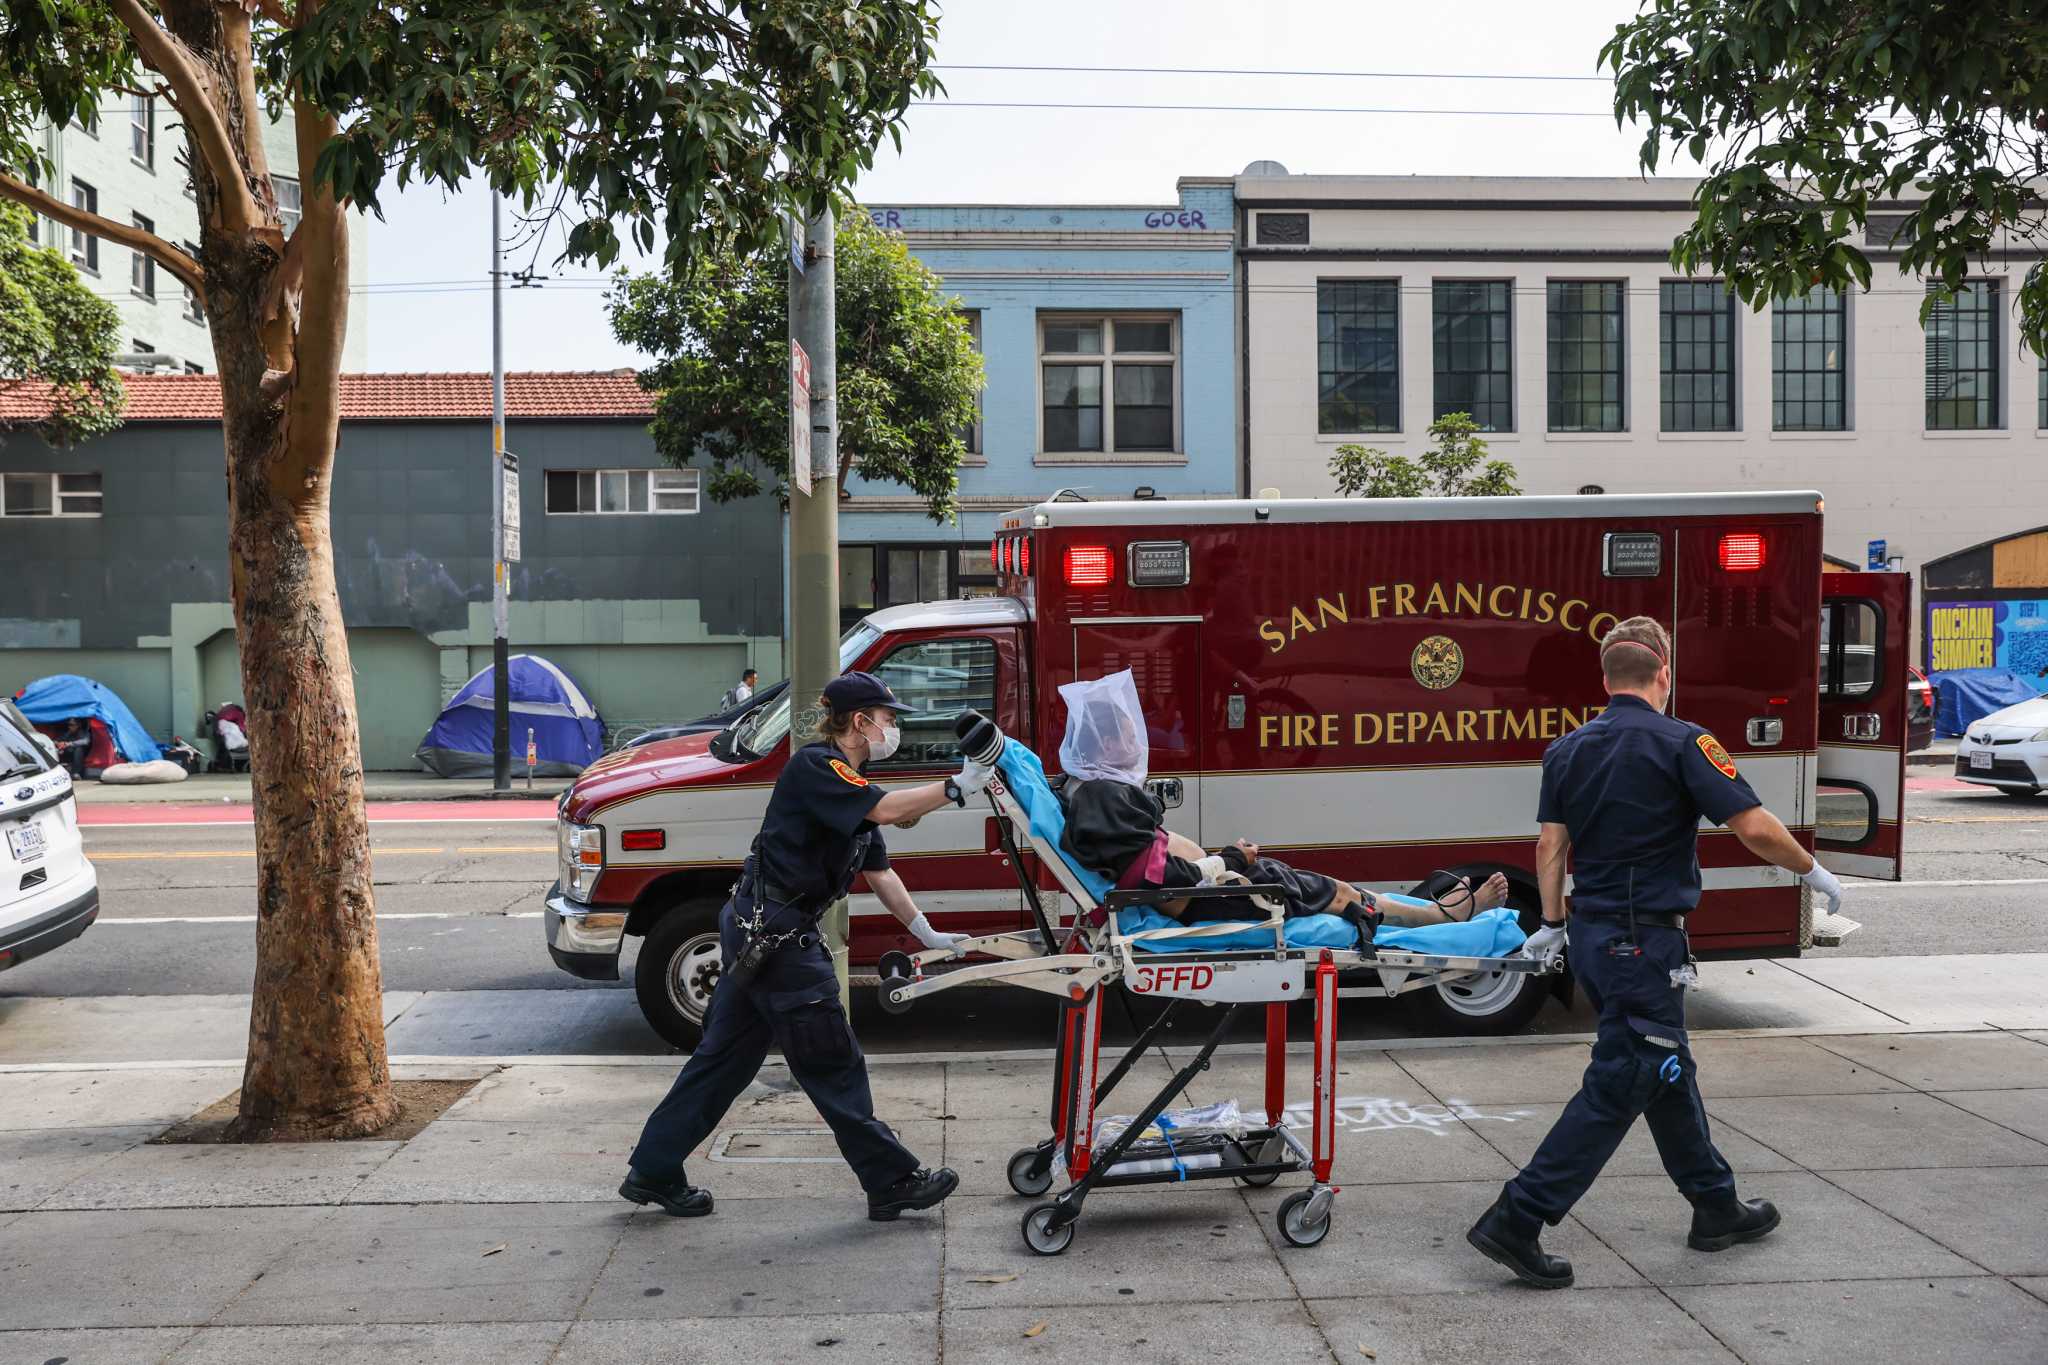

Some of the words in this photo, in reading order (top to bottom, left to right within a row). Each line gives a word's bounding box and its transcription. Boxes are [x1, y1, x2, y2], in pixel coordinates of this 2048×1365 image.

[1145, 210, 1206, 229] GOER
[1259, 592, 1349, 654] SAN
[1368, 582, 1619, 645] FRANCISCO
[1932, 608, 1993, 639] ONCHAIN
[1932, 639, 1993, 671] SUMMER
[1259, 714, 1339, 747] FIRE
[1133, 965, 1214, 993] SFFD
